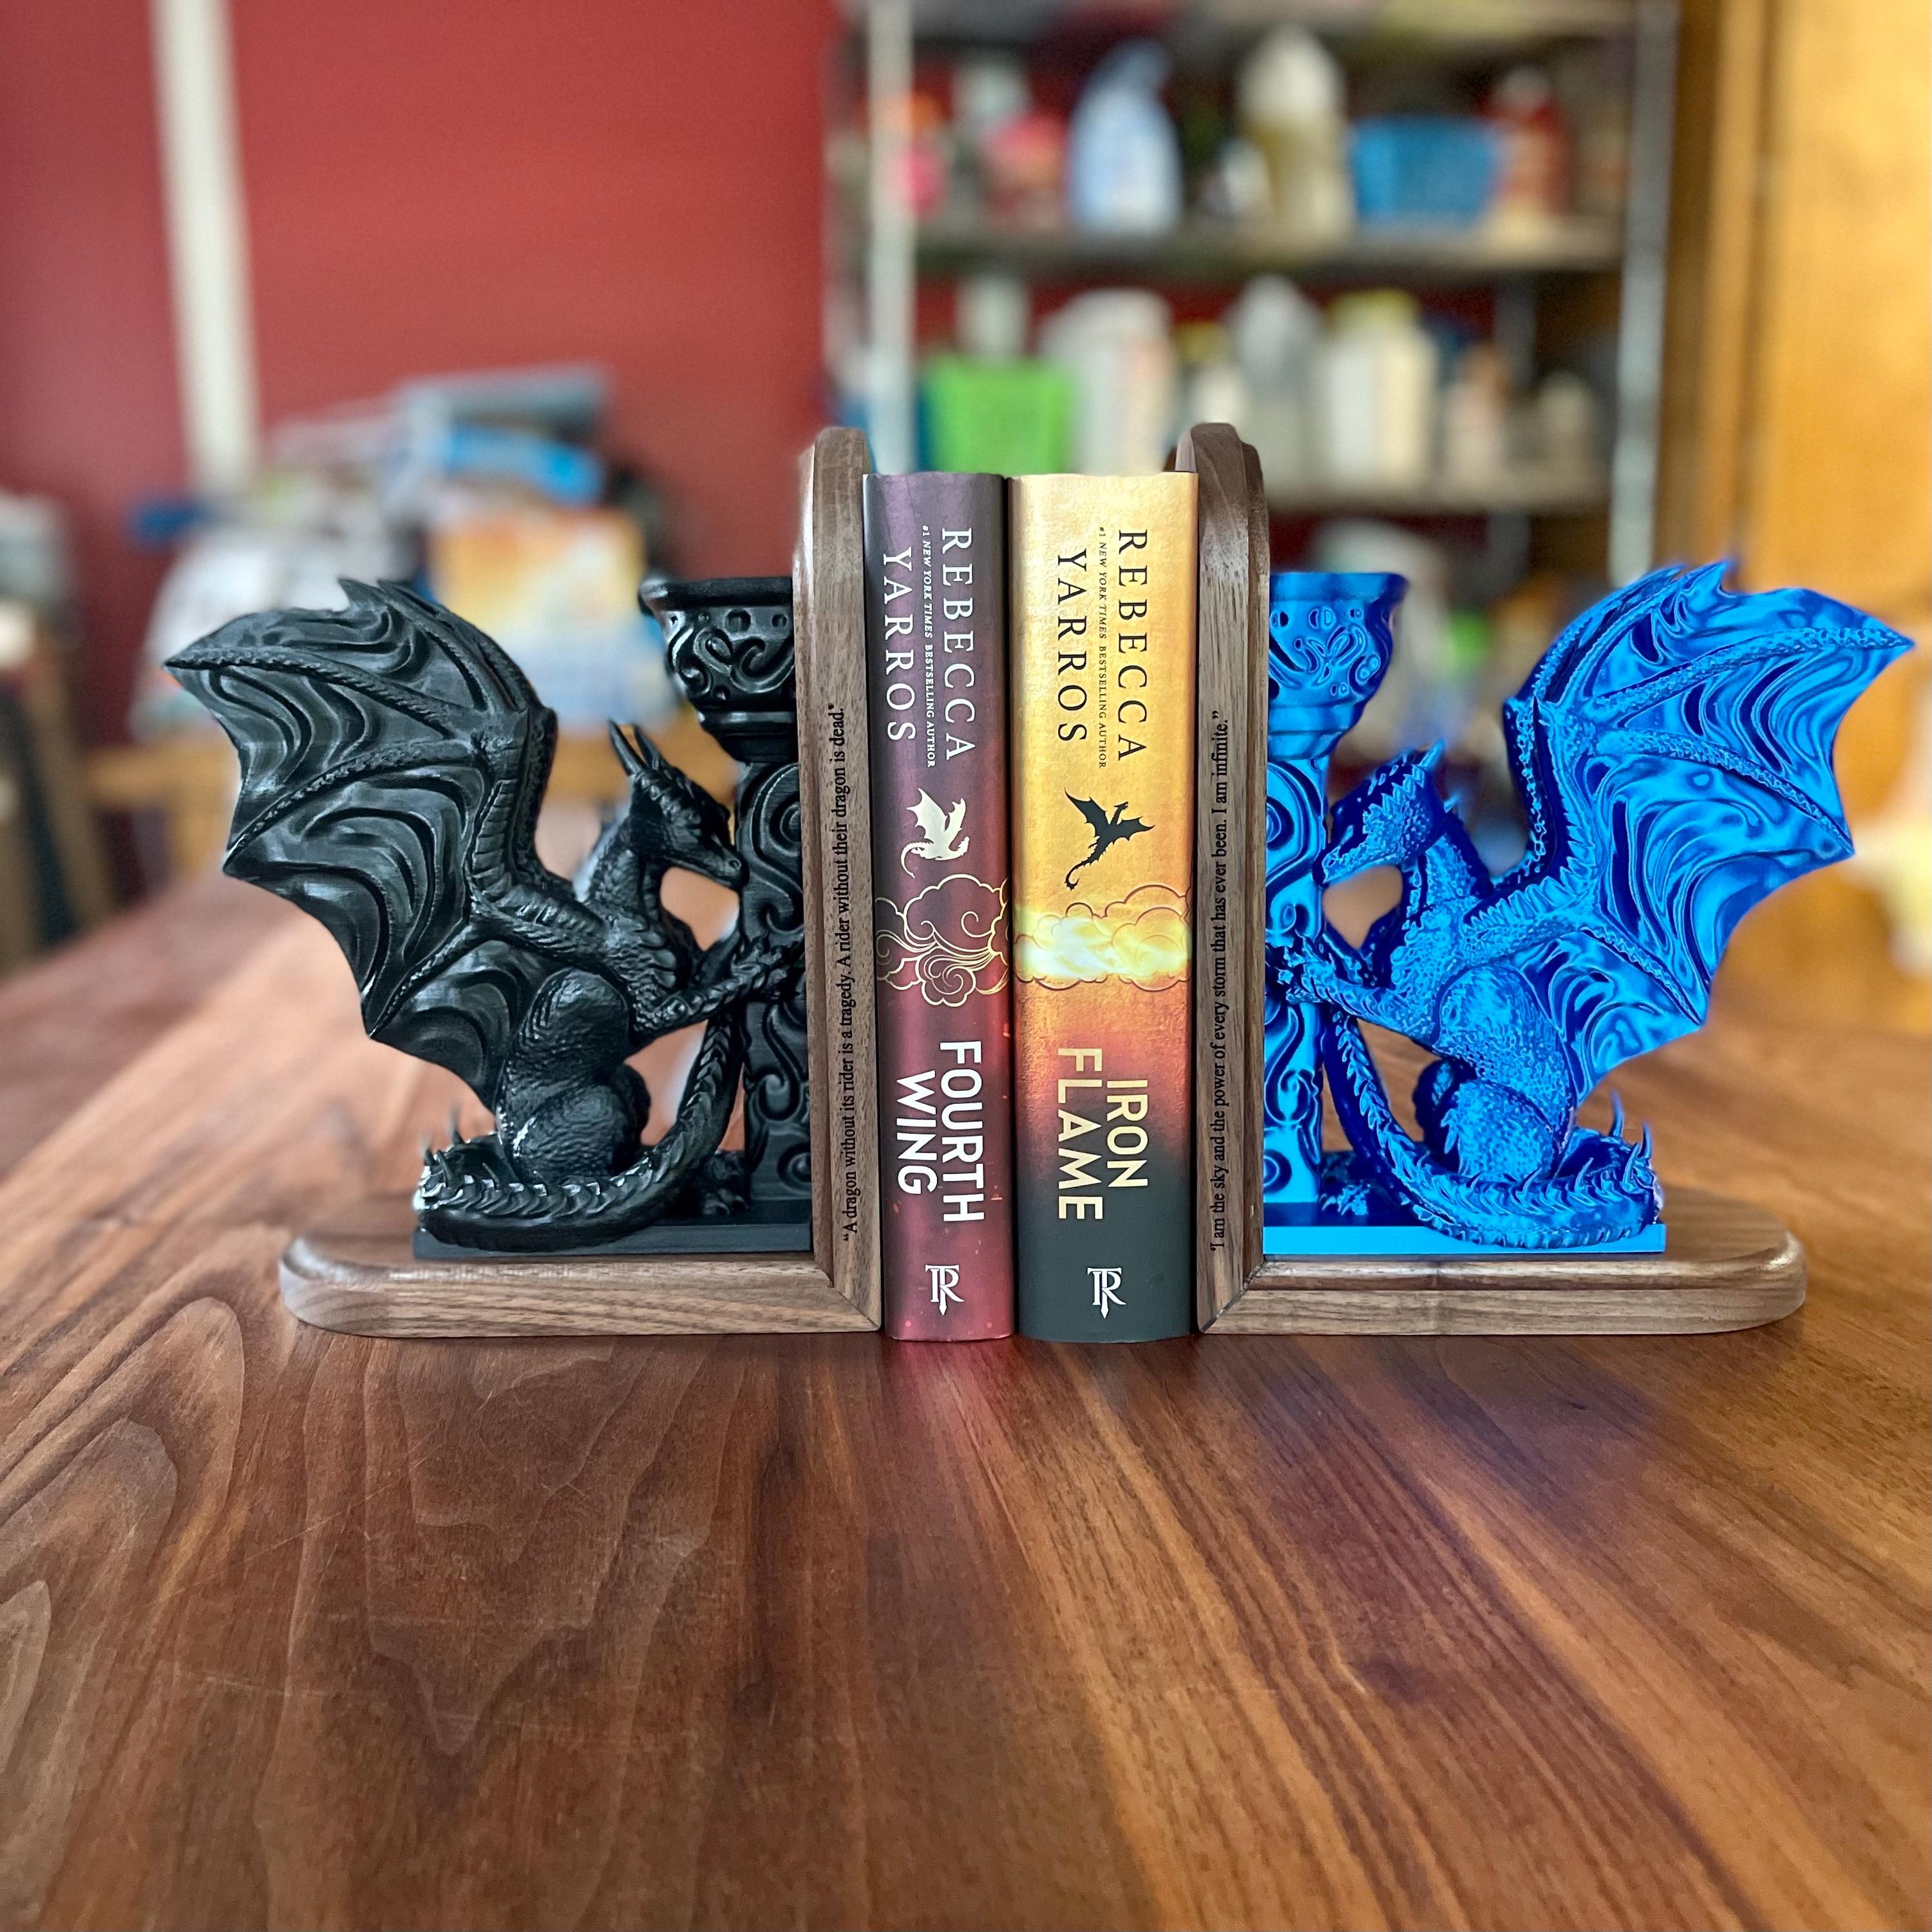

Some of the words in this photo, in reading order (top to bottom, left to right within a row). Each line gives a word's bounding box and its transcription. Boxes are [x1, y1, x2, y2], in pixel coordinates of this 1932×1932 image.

[922, 525, 931, 537] #1
[1099, 527, 1106, 536] #1
[923, 540, 931, 570] NEW
[923, 571, 933, 601] YORK
[923, 603, 933, 638] TIMES
[883, 546, 916, 741] YARROS
[942, 527, 976, 761] REBECCA
[1057, 548, 1087, 741] YARROS
[1118, 529, 1148, 761] REBECCA
[925, 644, 934, 718] BESTSELLING
[829, 752, 845, 762] is
[927, 721, 936, 767] AUTHOR
[831, 768, 849, 818] dragon
[1216, 782, 1227, 803] am
[832, 822, 848, 855] their
[1211, 820, 1227, 857] been.
[833, 860, 849, 914] without
[1215, 862, 1227, 893] ever
[1211, 898, 1226, 921] has
[835, 918, 850, 951] rider
[1211, 925, 1226, 952] that
[836, 955, 850, 968] A
[1213, 957, 1226, 997] storm
[836, 972, 855, 1026] tragedy.
[1213, 1001, 1229, 1040] every
[838, 1043, 853, 1054] is
[1210, 1042, 1225, 1059] of
[838, 1059, 854, 1091] rider
[1213, 1063, 1229, 1107] power
[840, 1095, 855, 1111] its
[896, 1070, 938, 1194] WING
[940, 1041, 985, 1221] FOURTH
[1058, 1048, 1103, 1219] FLAME
[1106, 1079, 1148, 1187] IRON
[1210, 1111, 1225, 1132] the
[840, 1117, 856, 1167] without
[1210, 1137, 1225, 1161] and
[1210, 1165, 1229, 1189] sky
[841, 1171, 860, 1218] dragon
[1210, 1194, 1225, 1213] the
[1213, 1218, 1225, 1238] am
